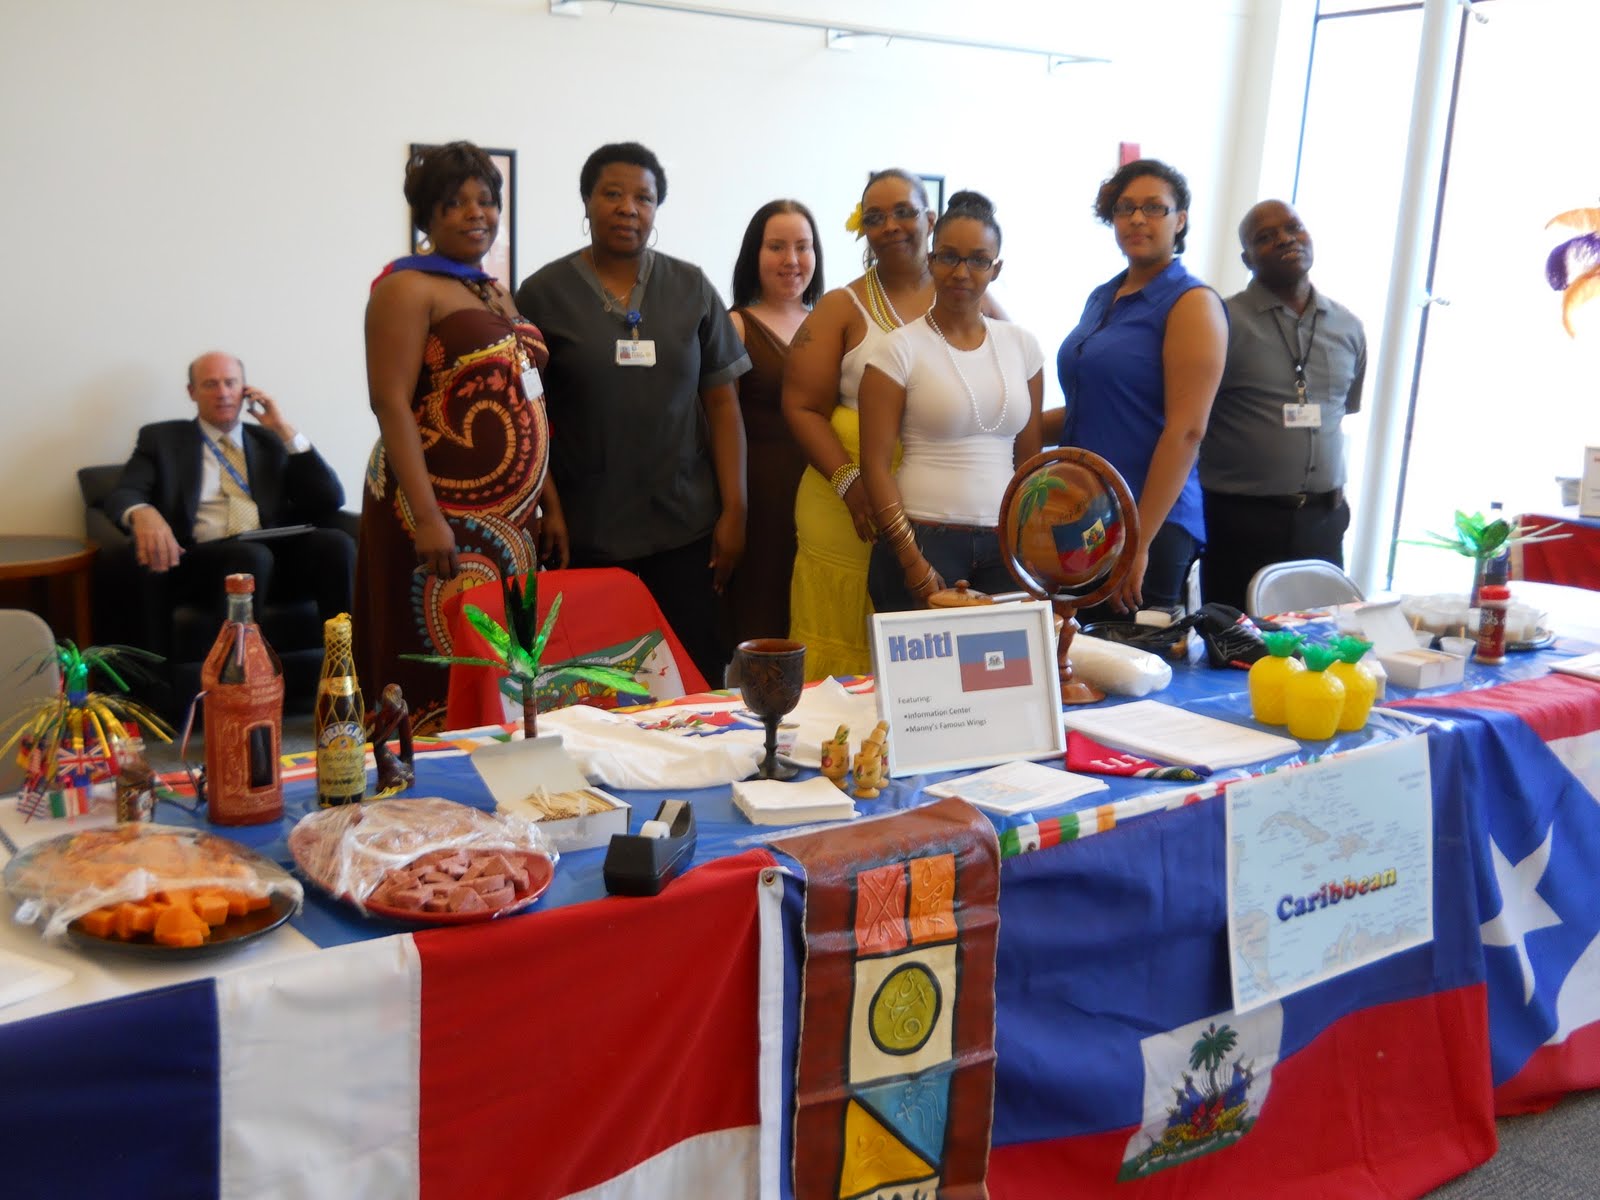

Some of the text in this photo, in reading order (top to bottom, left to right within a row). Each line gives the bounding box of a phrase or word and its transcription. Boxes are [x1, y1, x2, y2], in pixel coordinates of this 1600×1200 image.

[898, 695, 932, 704] Featuring:
[949, 706, 972, 715] Center
[909, 719, 987, 733] Manny's Famous Wings
[1276, 866, 1398, 922] Caribbean
